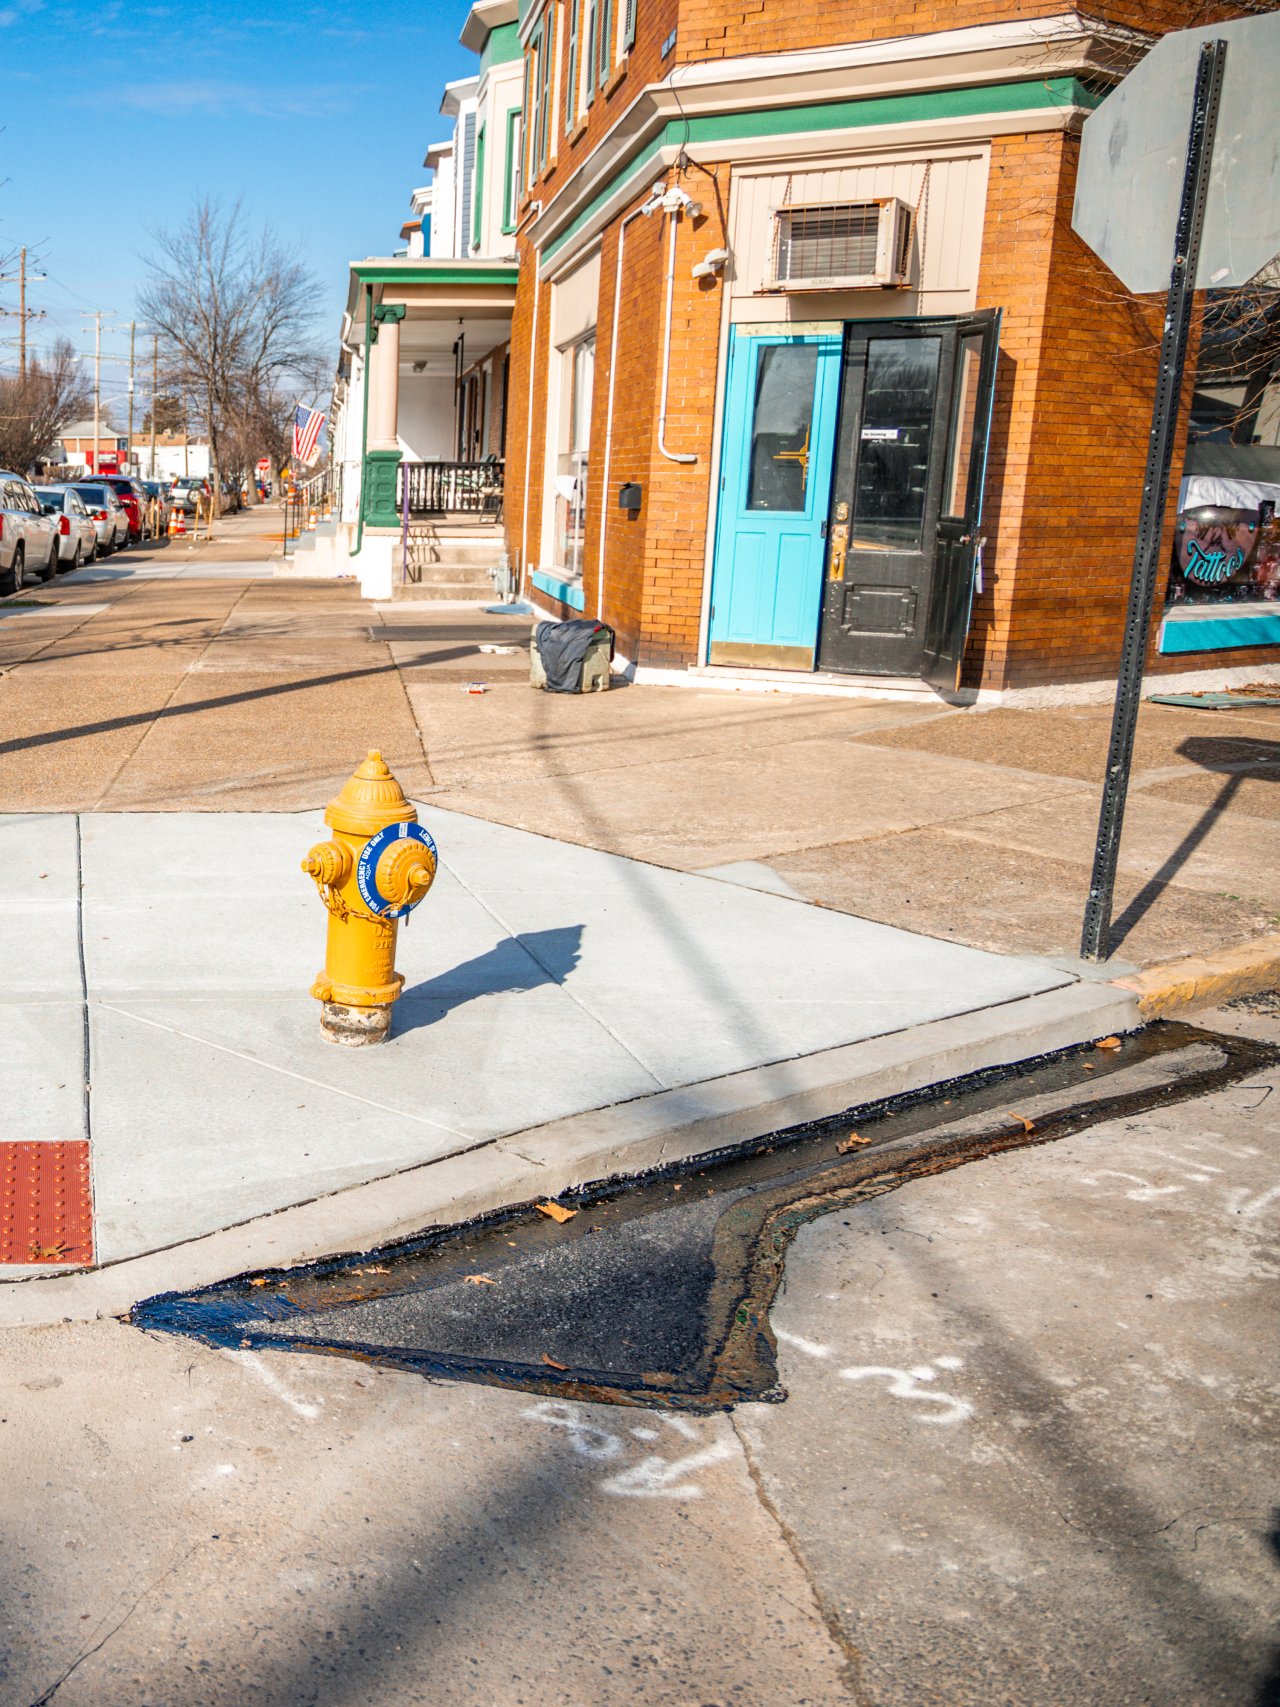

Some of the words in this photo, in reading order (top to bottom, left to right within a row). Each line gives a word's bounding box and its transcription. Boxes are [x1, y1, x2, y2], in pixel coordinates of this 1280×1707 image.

[1183, 540, 1244, 583] Tattoos
[370, 831, 385, 848] ONLY
[361, 845, 373, 861] USE
[358, 860, 372, 903] EMERGENCY
[368, 899, 380, 913] FOR
